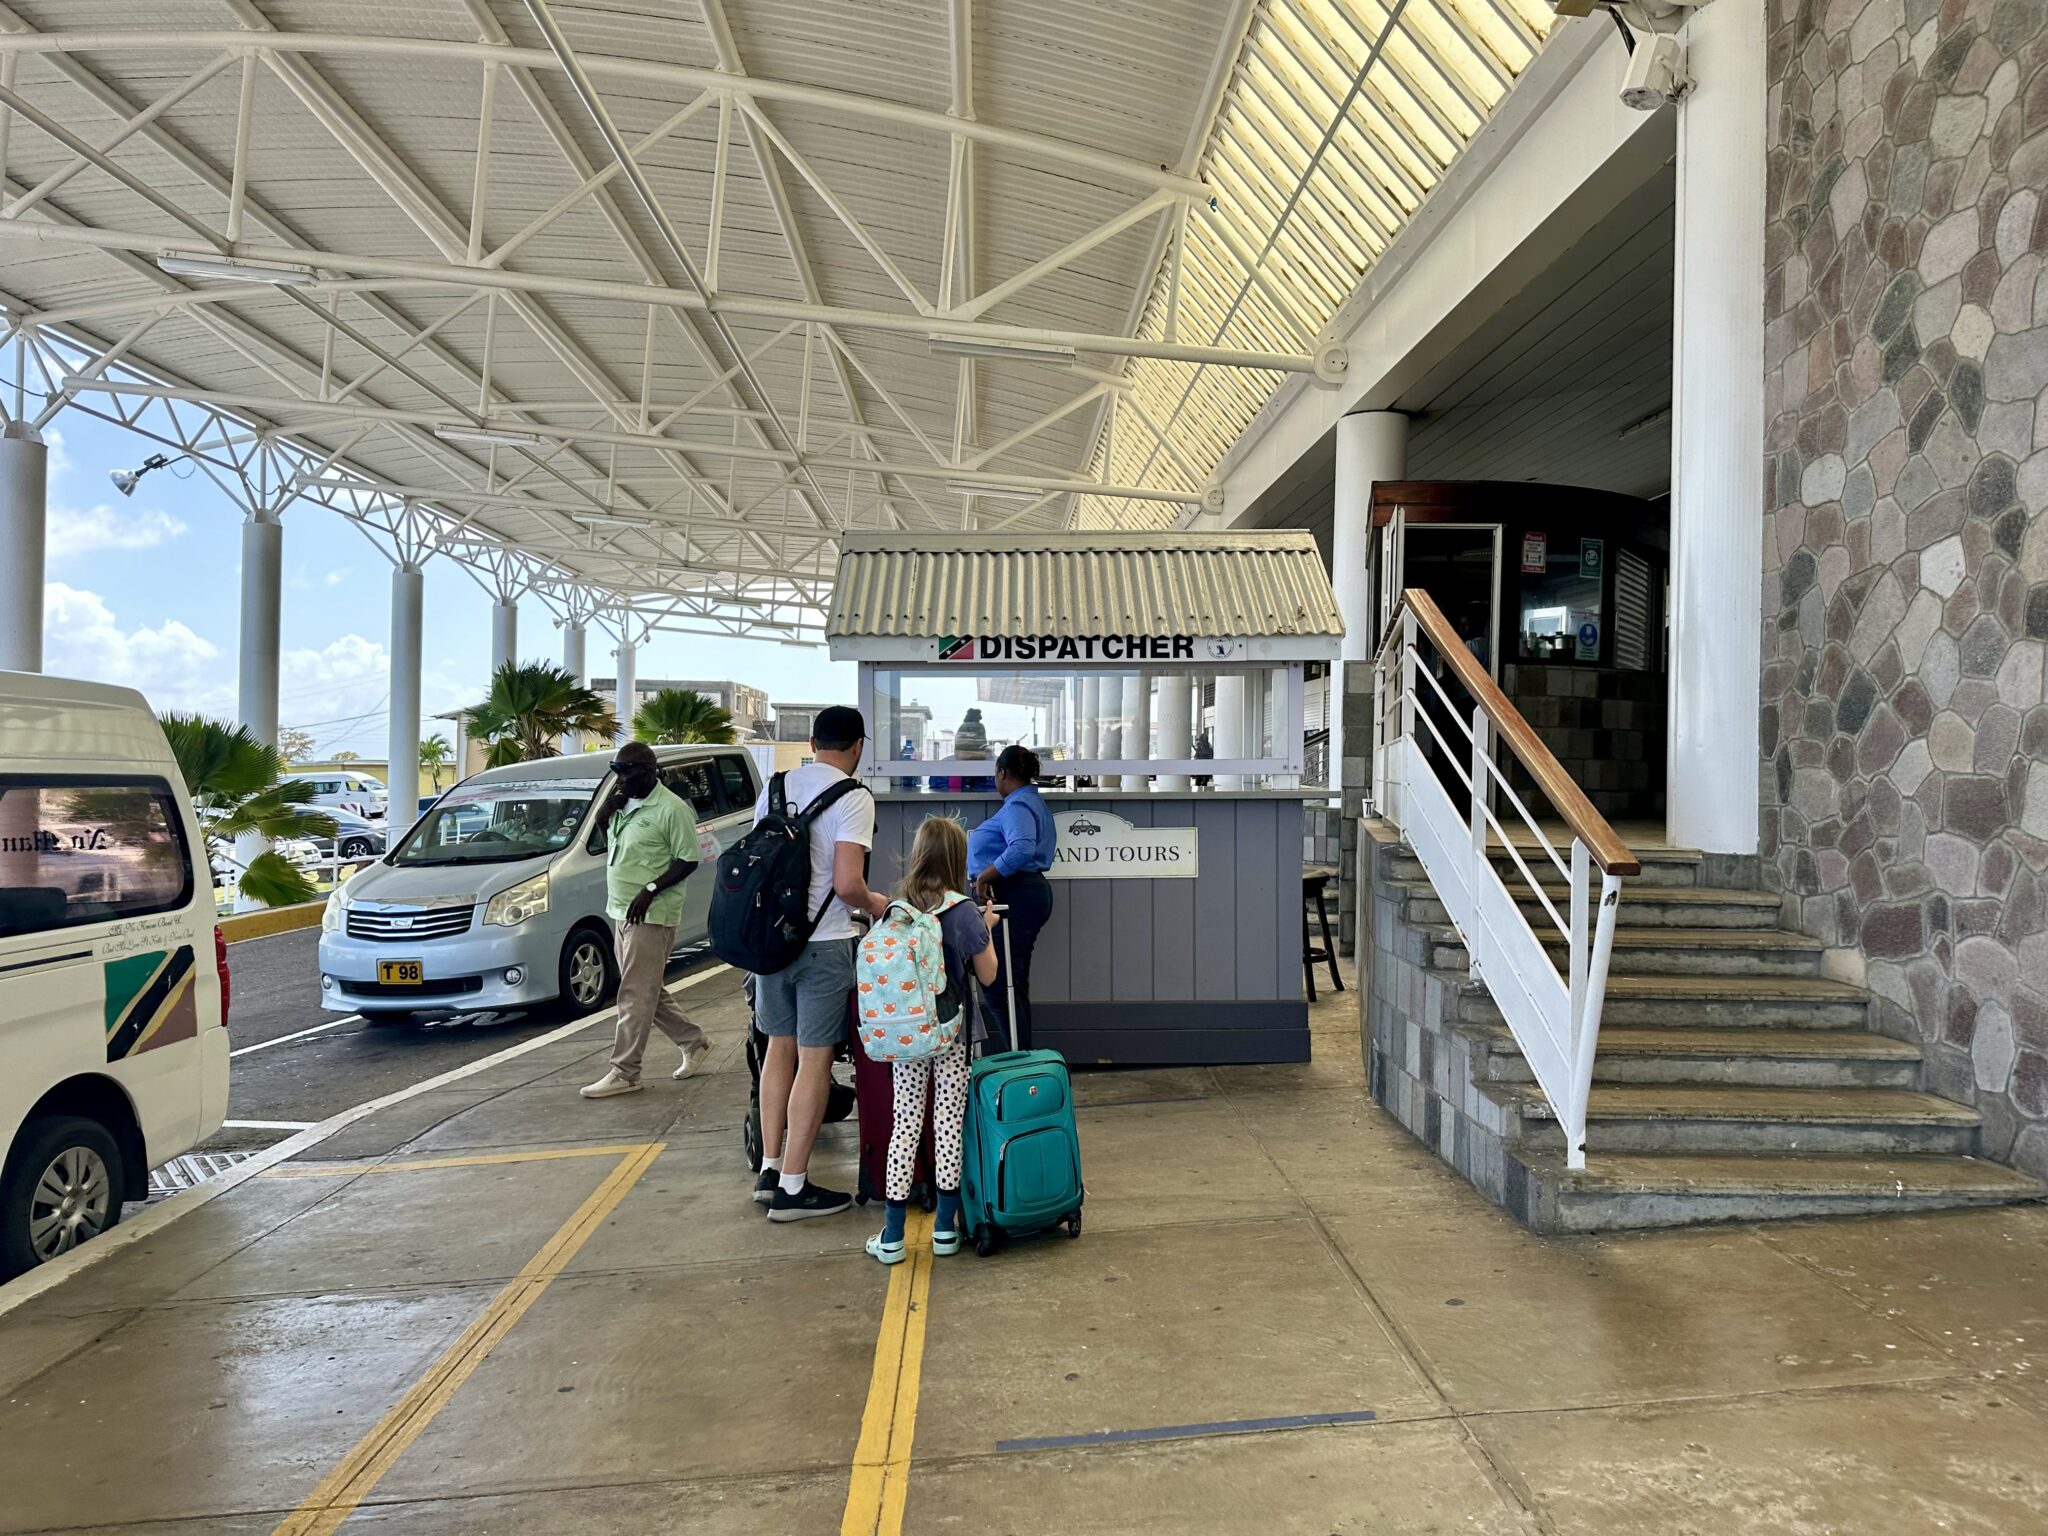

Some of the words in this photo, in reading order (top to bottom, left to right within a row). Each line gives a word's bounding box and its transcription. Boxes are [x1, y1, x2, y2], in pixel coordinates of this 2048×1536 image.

[980, 635, 1194, 660] DISPATCHER
[1105, 845, 1180, 862] TOURS
[383, 965, 393, 980] T
[398, 965, 418, 980] 98
